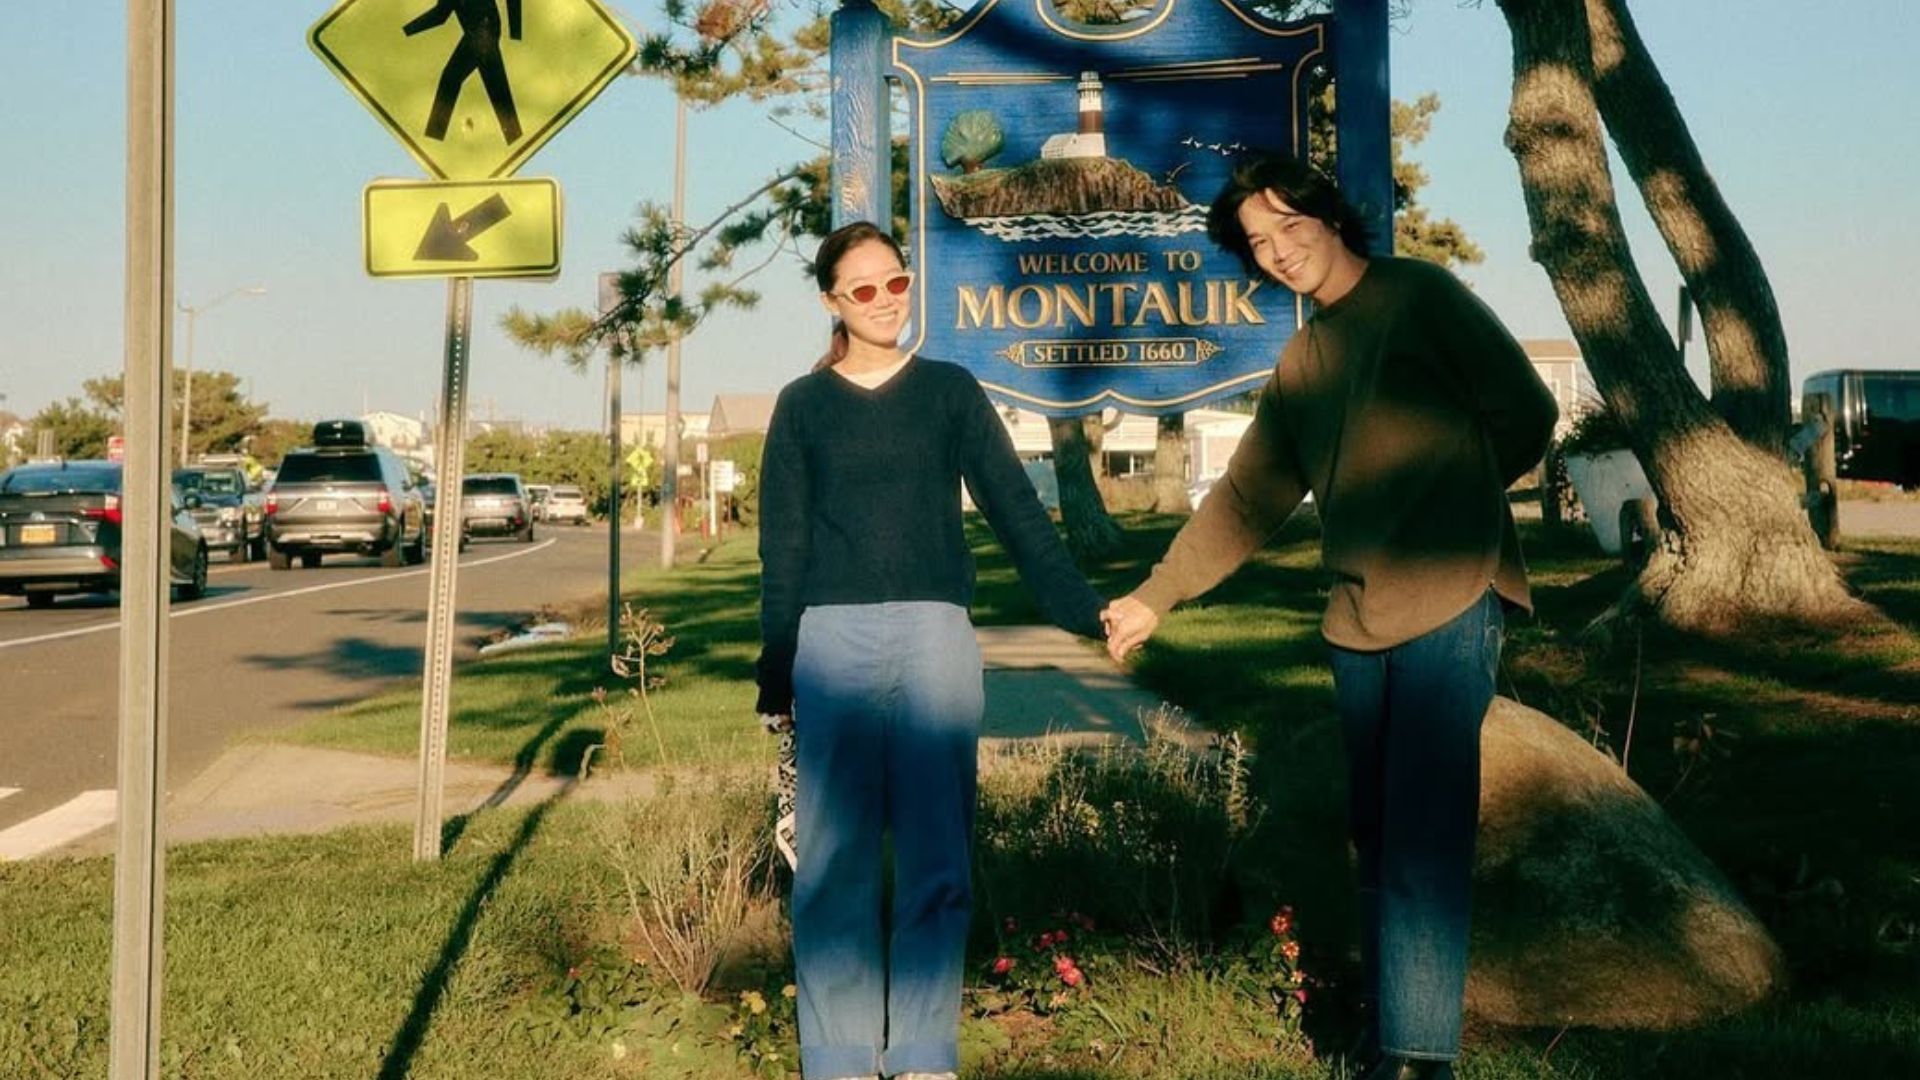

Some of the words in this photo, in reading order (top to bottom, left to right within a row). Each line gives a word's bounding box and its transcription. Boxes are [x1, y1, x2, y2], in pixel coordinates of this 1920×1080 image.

[1019, 252, 1148, 274] WELCOME
[1163, 250, 1201, 272] TO
[956, 281, 1266, 330] MONTAUK
[1034, 343, 1128, 363] SETTLED
[1139, 342, 1187, 361] 1660
